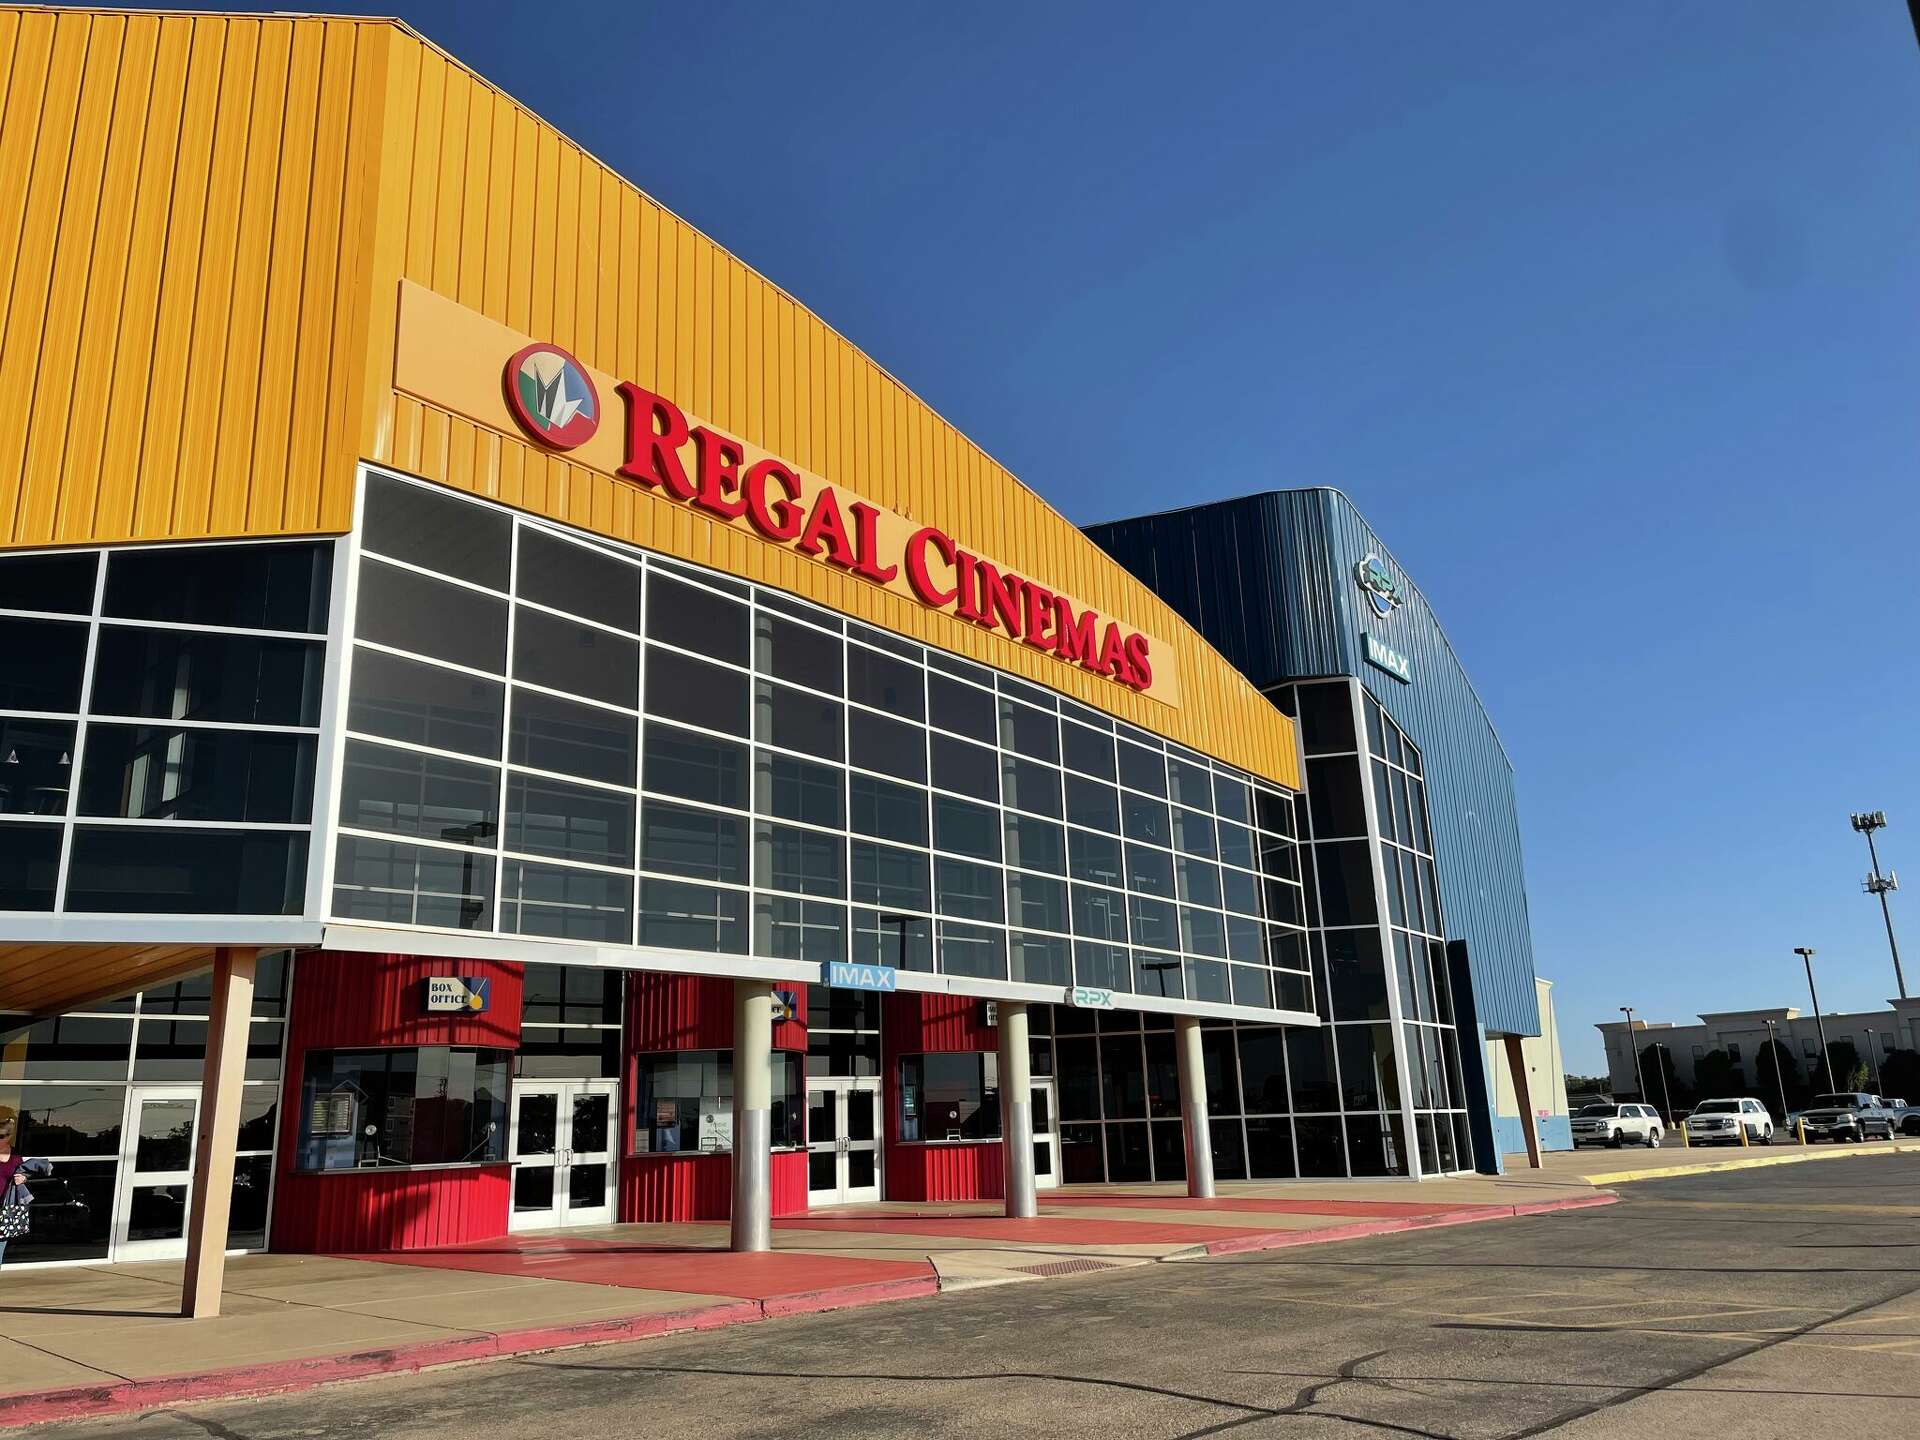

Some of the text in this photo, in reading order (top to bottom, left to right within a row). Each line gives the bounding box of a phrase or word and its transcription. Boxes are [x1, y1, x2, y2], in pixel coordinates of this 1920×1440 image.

[614, 380, 1153, 691] REGAL CINEMAS
[1368, 636, 1410, 680] IMAX
[832, 965, 891, 989] IMAX
[431, 983, 453, 992] BOX
[1075, 989, 1112, 1006] RPX
[431, 994, 467, 1004] OFFICE
